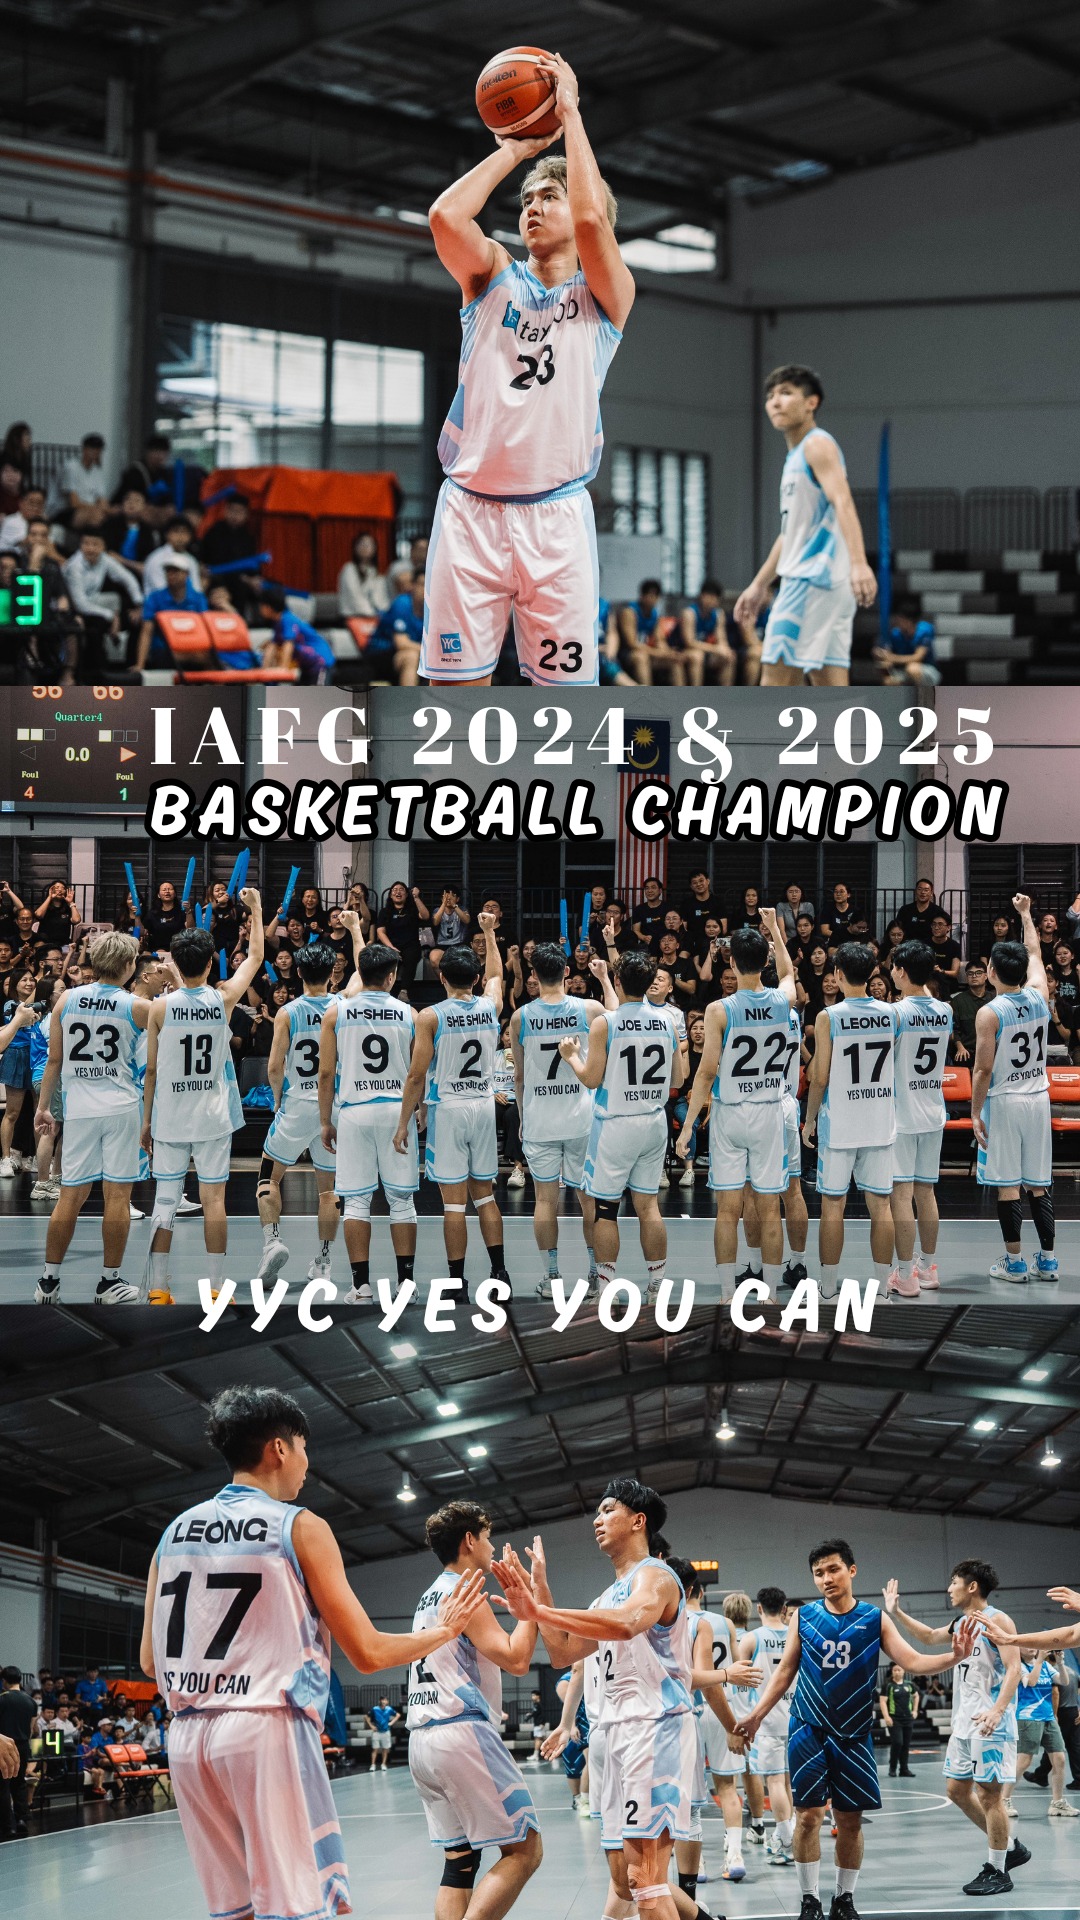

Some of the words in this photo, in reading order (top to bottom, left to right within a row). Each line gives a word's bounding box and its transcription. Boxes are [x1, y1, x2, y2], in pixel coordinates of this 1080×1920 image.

[481, 69, 517, 92] molten
[495, 96, 515, 112] FIBA
[509, 344, 556, 391] 23
[15, 574, 43, 626] 3
[538, 638, 583, 673] 23
[55, 711, 103, 722] Quarter4
[65, 747, 90, 762] 0.0
[21, 770, 40, 779] Foul
[115, 772, 135, 781] Foul
[23, 785, 35, 799] 4
[118, 787, 129, 801] 1
[78, 997, 117, 1011] SHIN
[172, 1007, 189, 1021] YIH
[190, 1007, 222, 1020] HONG
[306, 1013, 323, 1026] IA
[346, 1008, 404, 1021] N-SHEN
[446, 1015, 465, 1028] SHE
[467, 1012, 493, 1027] SHIAN
[745, 1006, 773, 1021] NIK
[908, 1015, 925, 1027] JIN
[926, 1014, 948, 1026] HAO
[529, 1018, 543, 1030] YU
[546, 1015, 577, 1030] HENG
[617, 1019, 642, 1031] JOE
[644, 1019, 667, 1031] JEN
[841, 1015, 891, 1030] LEONG
[68, 1022, 120, 1063] 23
[1010, 1025, 1044, 1069] 31
[179, 1034, 213, 1076] 13
[361, 1033, 390, 1074] 9
[459, 1039, 482, 1079] 2
[540, 1041, 563, 1080] 7
[731, 1031, 787, 1077] 22
[913, 1037, 940, 1075] 5
[619, 1044, 666, 1085] 12
[843, 1041, 891, 1084] 17
[75, 1067, 89, 1077] YES
[89, 1066, 104, 1077] YOU
[171, 1082, 186, 1093] YES
[187, 1081, 203, 1092] YOU
[204, 1080, 213, 1091] CA
[300, 1081, 314, 1090] YES
[354, 1080, 368, 1091] YES
[369, 1080, 385, 1090] YOU
[386, 1079, 401, 1090] CAN
[533, 1086, 547, 1097] YES
[548, 1084, 563, 1096] YOU
[564, 1083, 580, 1095] CAN
[738, 1081, 753, 1093] YES
[764, 1077, 781, 1089] CAN
[624, 1090, 639, 1101] YES
[847, 1089, 860, 1101] YES
[860, 1088, 876, 1099] YOU
[877, 1087, 891, 1098] CAN
[172, 1518, 268, 1544] LEONG
[160, 1571, 262, 1660] 17
[764, 1638, 775, 1649] YU
[822, 1640, 851, 1669] 23
[604, 1650, 614, 1682] 2
[177, 1671, 211, 1694] YOU
[214, 1673, 251, 1696] CAN
[46, 1731, 60, 1755] 4
[624, 1799, 639, 1825] 2
